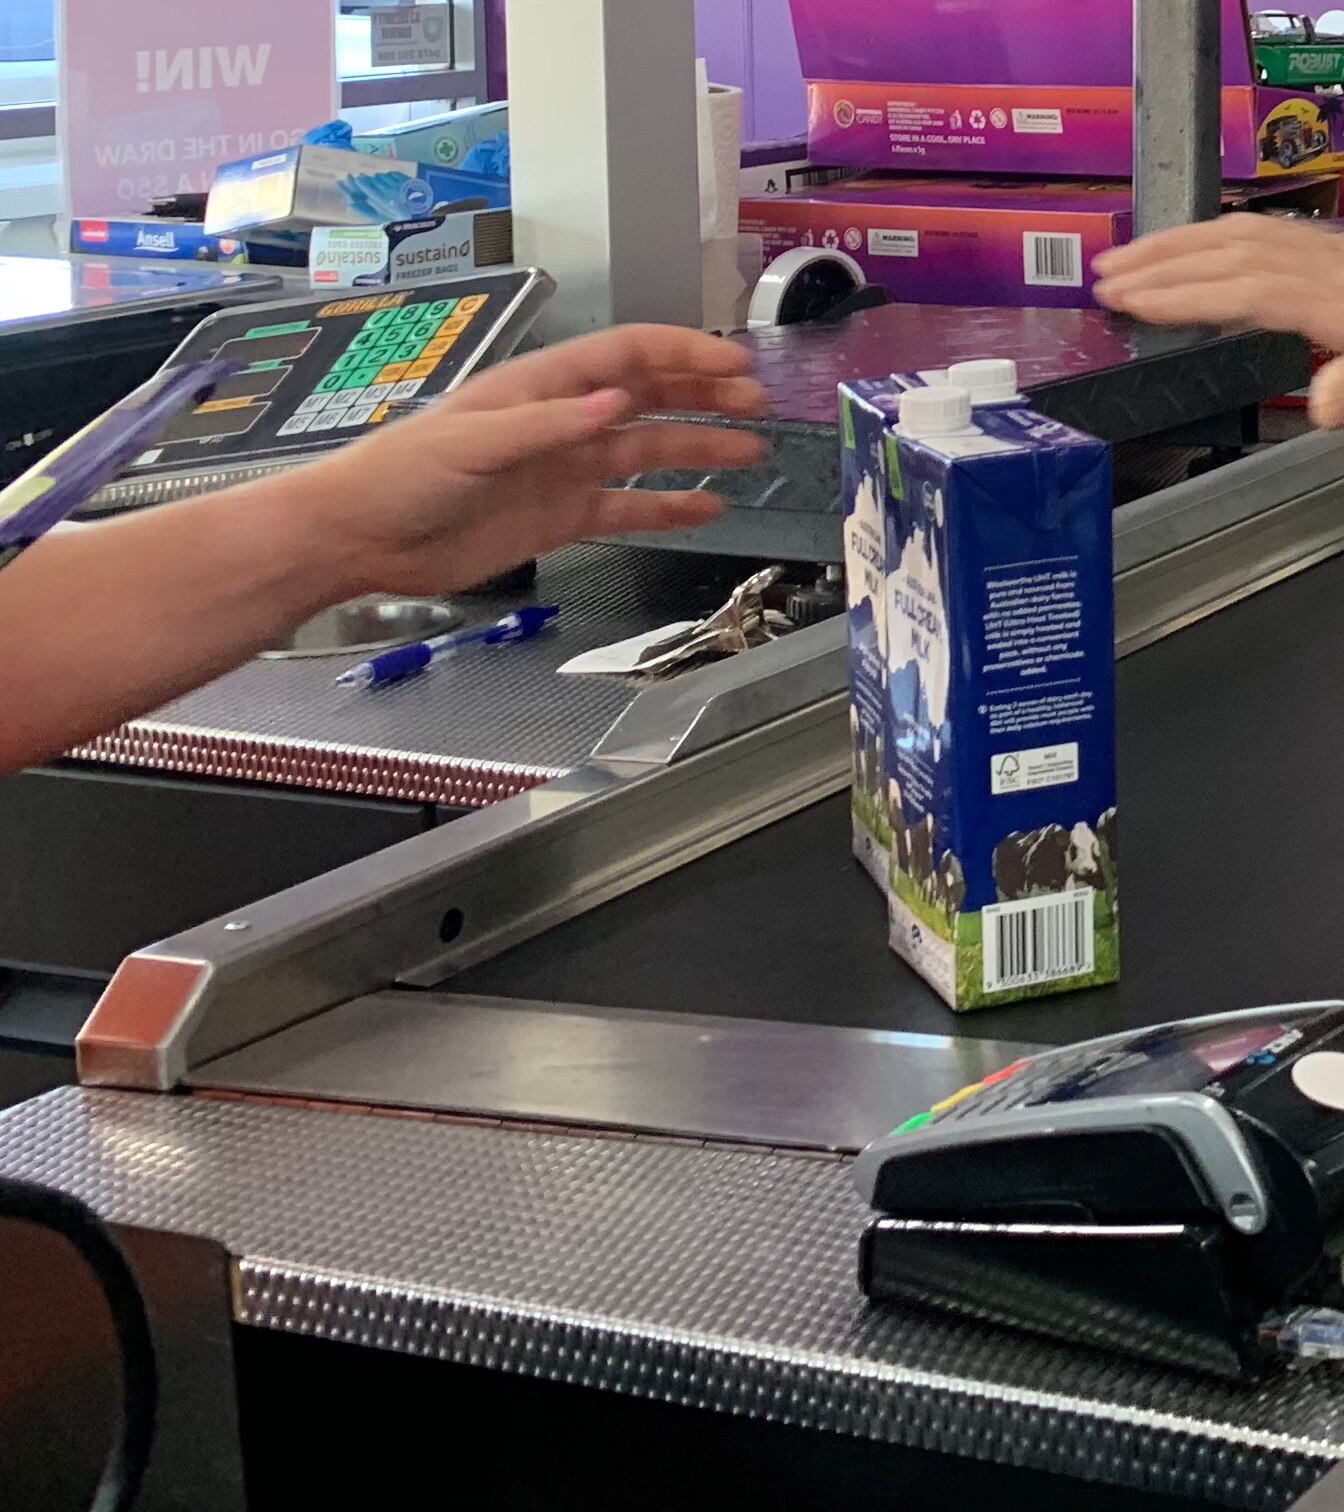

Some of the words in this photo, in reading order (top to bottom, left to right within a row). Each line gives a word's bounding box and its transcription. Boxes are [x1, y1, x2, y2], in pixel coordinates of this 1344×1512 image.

[1289, 51, 1341, 73] ROBUST
[137, 230, 175, 248] Ansell
[373, 310, 390, 326] 7
[400, 305, 419, 320] 8
[430, 301, 448, 316] 9
[460, 297, 479, 312] C
[356, 331, 375, 346] 4
[384, 328, 400, 342] 5
[414, 321, 433, 337] 6
[368, 348, 386, 364] 2
[399, 343, 418, 359] 3
[323, 373, 339, 389] 0
